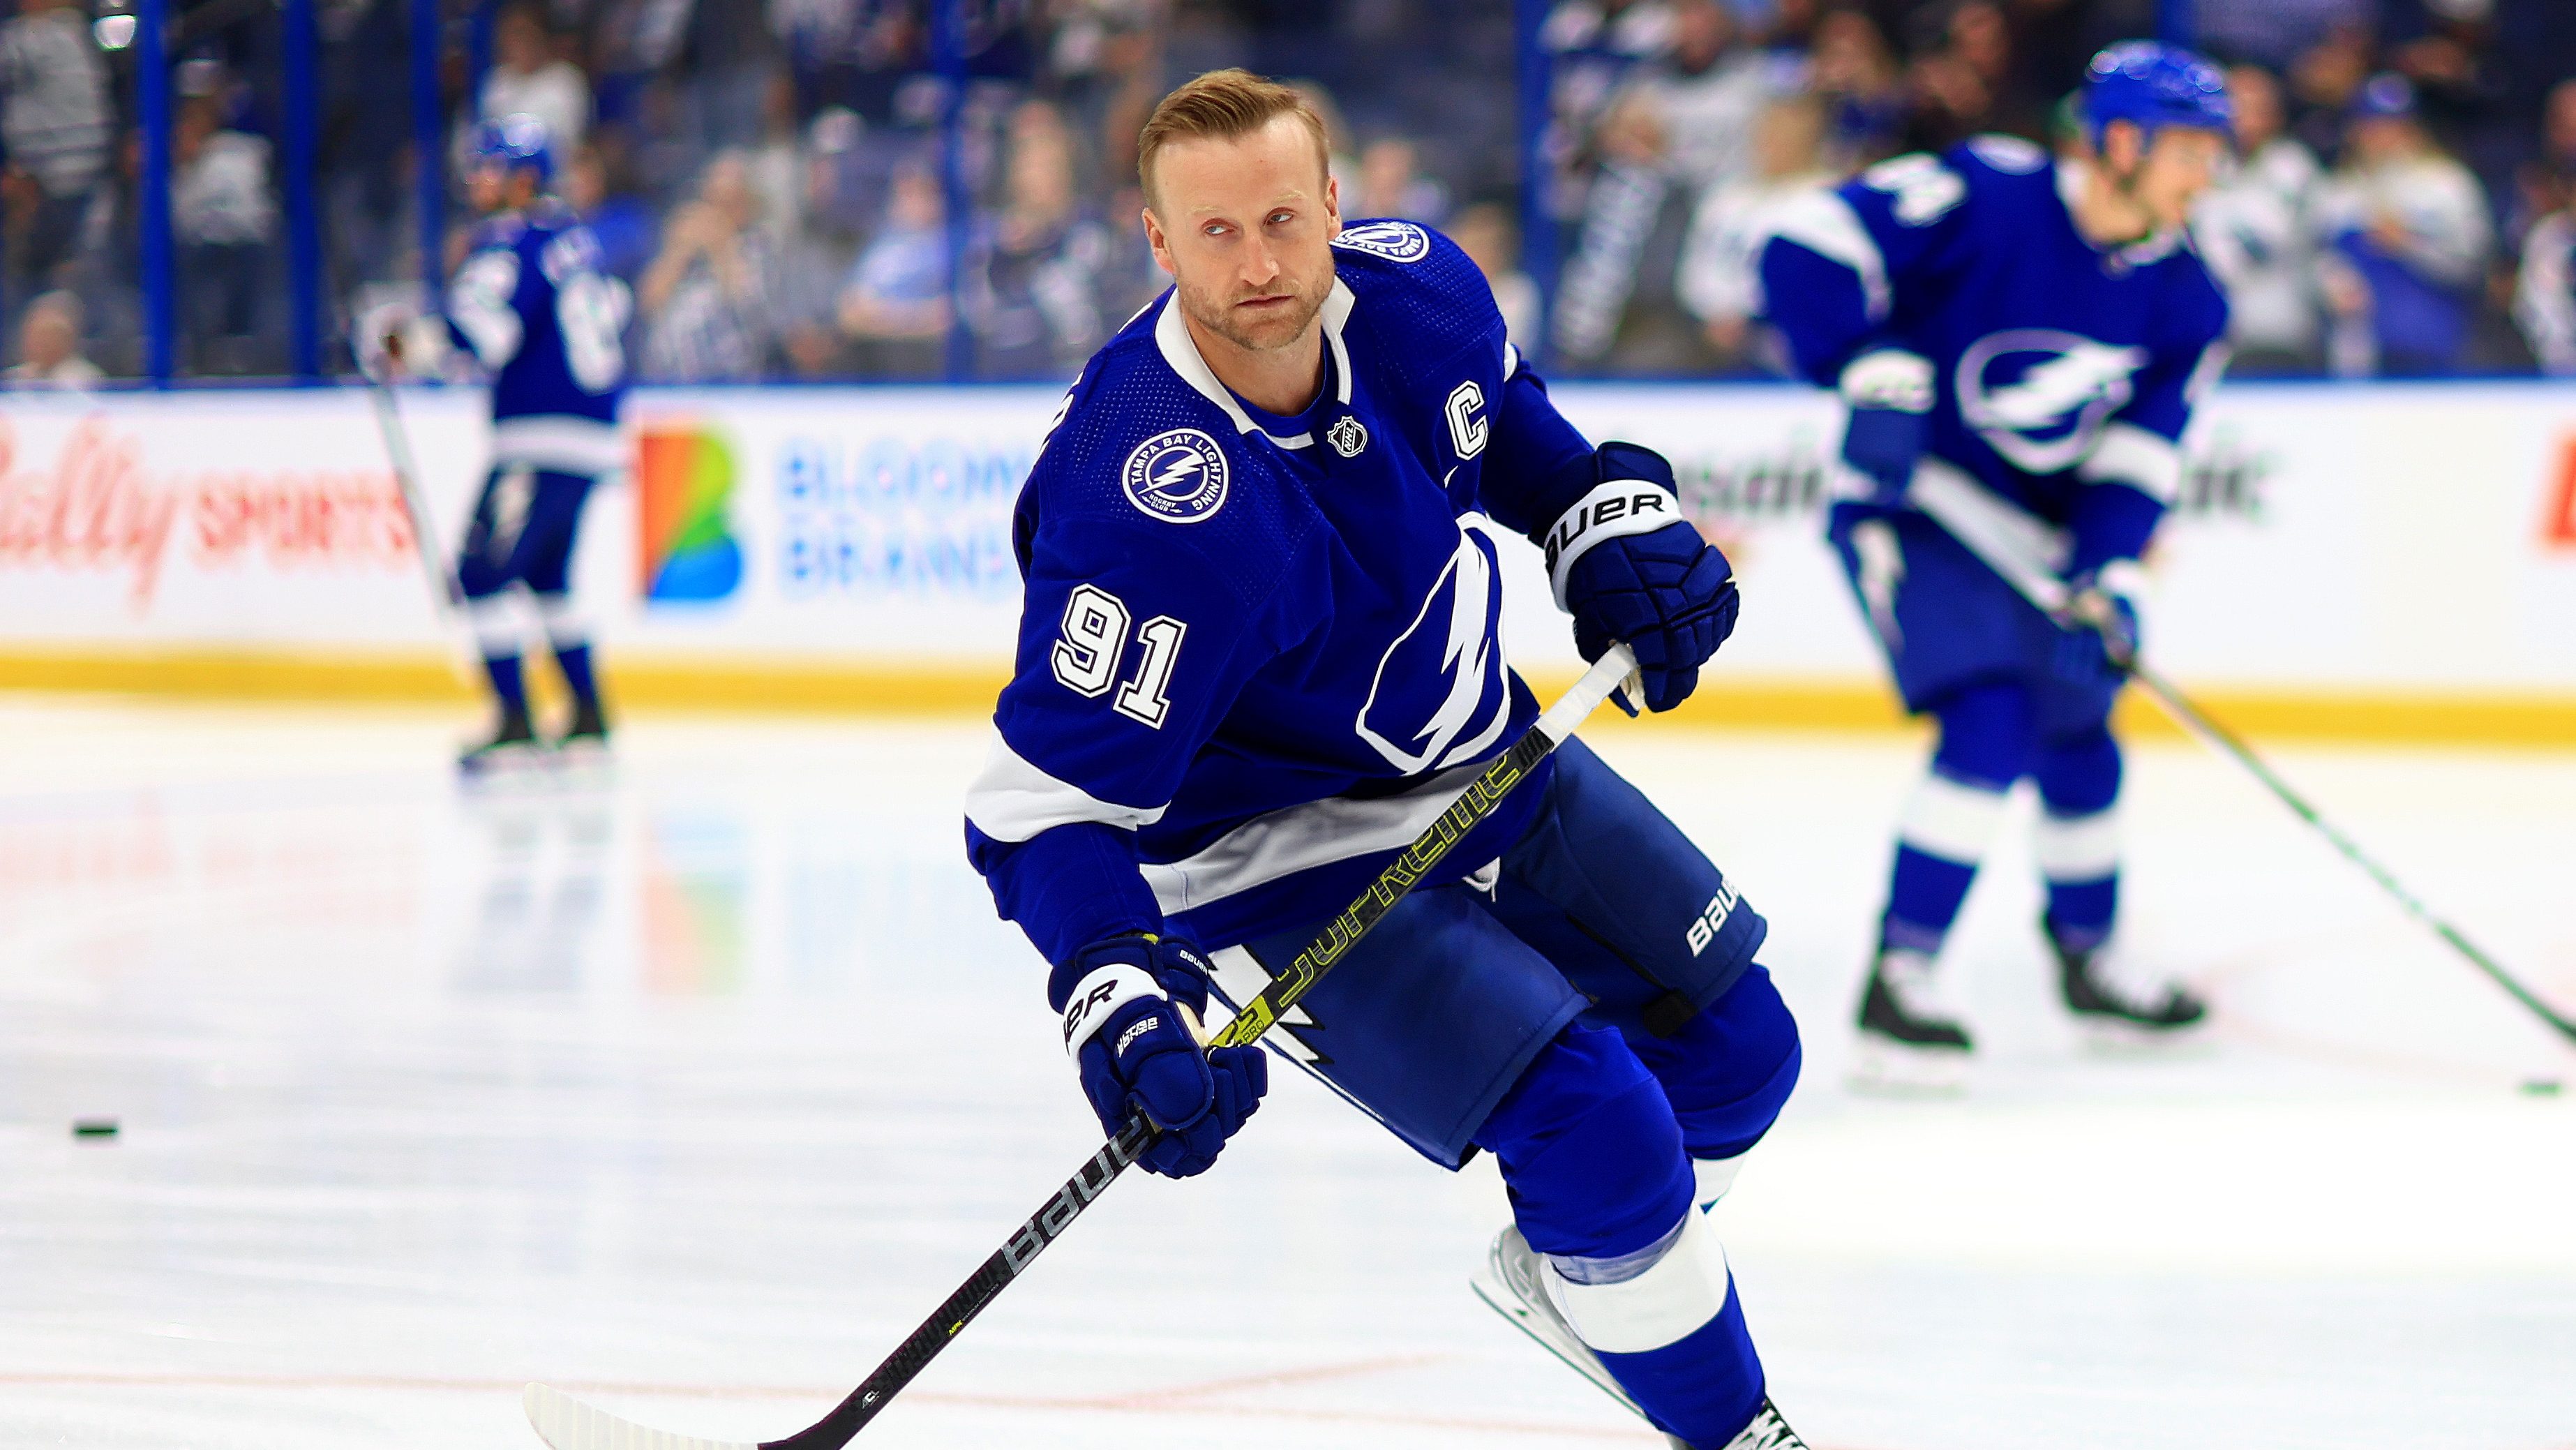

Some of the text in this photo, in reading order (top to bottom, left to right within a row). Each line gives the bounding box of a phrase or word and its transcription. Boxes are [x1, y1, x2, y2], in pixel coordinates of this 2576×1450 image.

[1343, 426, 1354, 451] NHL
[1444, 380, 1489, 461] C
[1131, 435, 1221, 511] TAMPA BAY LIGHTNING
[1545, 494, 1665, 581] AUER
[1051, 583, 1188, 730] 91
[1243, 1019, 1264, 1043] PRO
